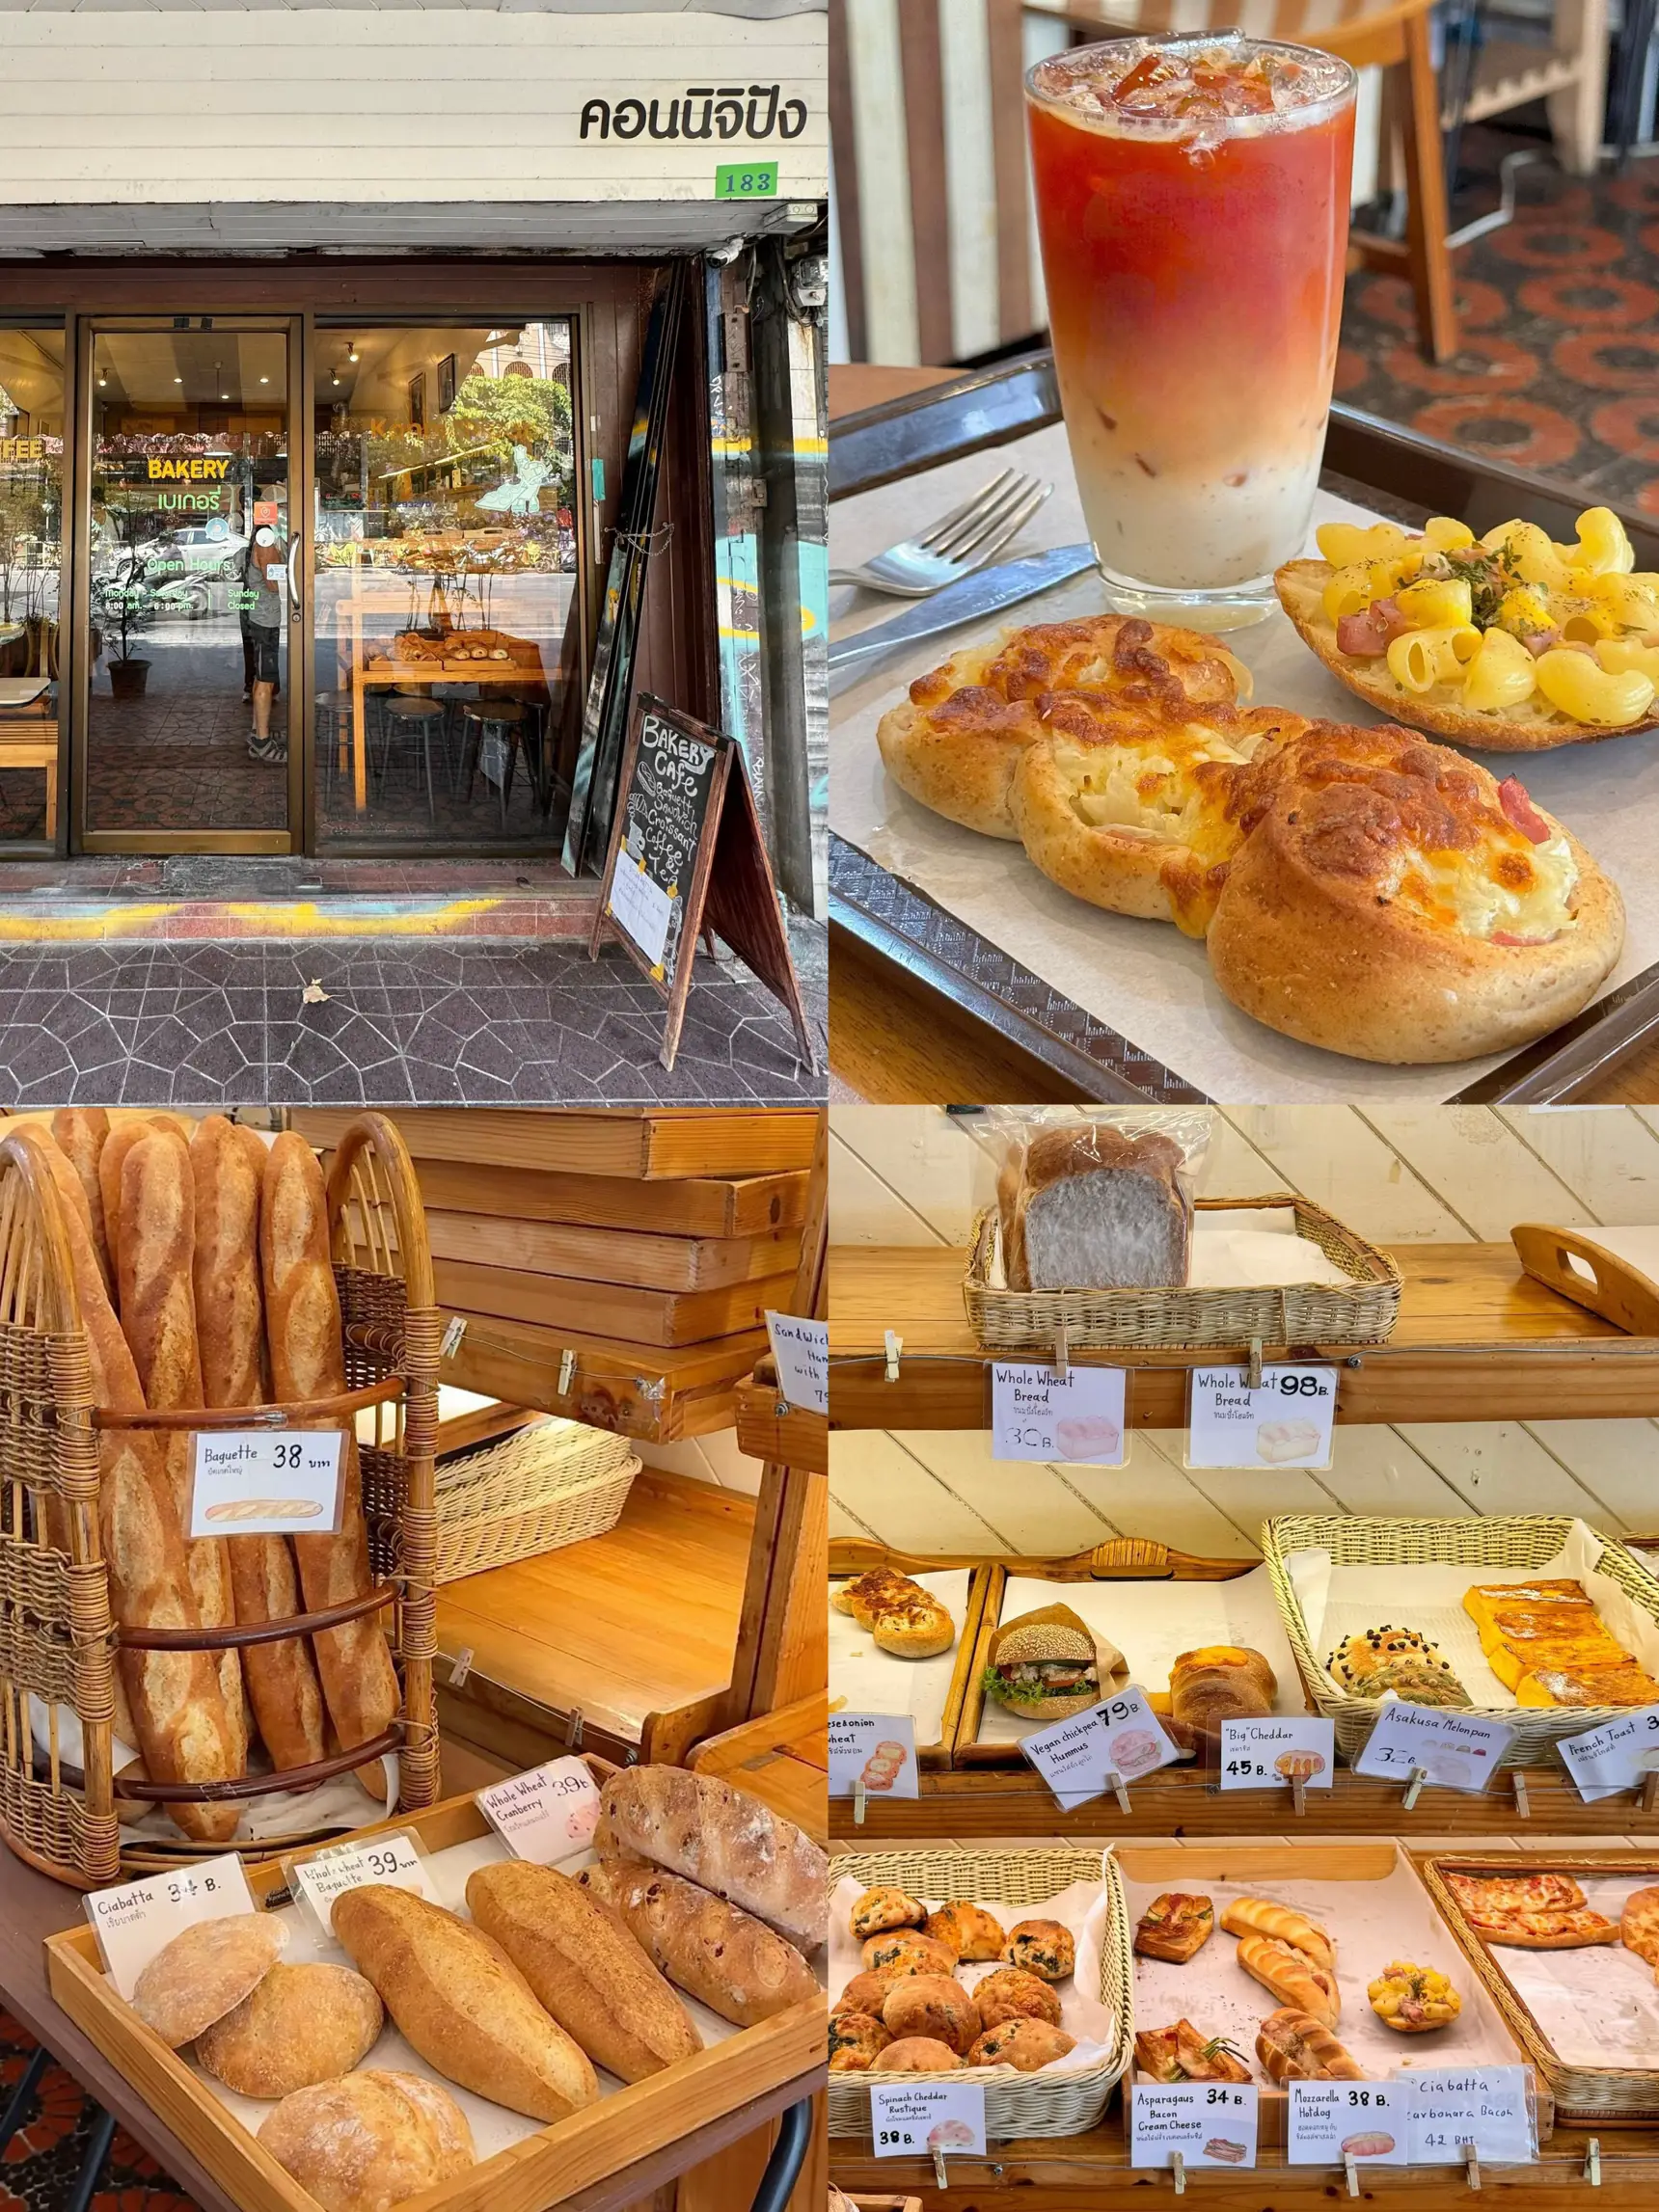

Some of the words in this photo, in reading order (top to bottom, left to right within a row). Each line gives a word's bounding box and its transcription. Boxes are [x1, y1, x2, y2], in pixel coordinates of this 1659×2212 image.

[580, 84, 807, 139] คอนนิจิปัง
[724, 173, 771, 193] 183
[0, 439, 42, 458] FEE
[148, 459, 229, 479] BAKERY
[147, 558, 184, 573] Open
[191, 556, 231, 571] Hours
[228, 588, 259, 601] Sunday
[228, 601, 256, 610] Closed
[642, 715, 715, 775] BAKERY
[645, 826, 684, 867] Coffee
[795, 1365, 820, 1380] with
[996, 1369, 1033, 1385] Whole
[1037, 1370, 1074, 1388] Wheat
[1198, 1373, 1235, 1389] Whole
[1239, 1372, 1278, 1389] Wat
[1014, 1389, 1049, 1403] Bread
[1215, 1392, 1251, 1407] Bread
[204, 1443, 258, 1465] Baguette
[272, 1443, 303, 1469] 38
[309, 1459, 331, 1469] บาท
[1384, 1707, 1439, 1729] Asakusa
[1442, 1719, 1491, 1740] Melonpan
[1030, 1740, 1061, 1756] Vegan
[1062, 1720, 1099, 1742] chickpea
[1250, 1728, 1293, 1740] Cheddar
[1568, 1736, 1604, 1756] French
[1605, 1721, 1636, 1741] Toast
[1049, 1742, 1089, 1764] Hummus
[1226, 1761, 1252, 1775] 45
[486, 1789, 517, 1809] Whole
[514, 1772, 547, 1796] Wheat
[496, 1799, 544, 1821] Cranberry
[367, 1851, 398, 1876] 39
[97, 1890, 154, 1915] Ciabatta
[204, 1877, 222, 1892] B.
[1420, 2078, 1489, 2092] Ciabatta
[879, 2092, 912, 2106] Spinach
[913, 2091, 948, 2101] Cheddar
[1206, 2089, 1229, 2104] 34
[1294, 2088, 1340, 2103] Mozzarella
[1348, 2091, 1370, 2106] 38
[1375, 2094, 1390, 2107] B.
[889, 2104, 928, 2115] Rustique
[1150, 2110, 1177, 2118] Bacon
[1299, 2106, 1331, 2119] Hotdog
[1481, 2105, 1513, 2117] Bacon
[1138, 2120, 1168, 2131] Cream
[1169, 2120, 1202, 2129] Cheese
[880, 2130, 900, 2145] 38
[1425, 2134, 1447, 2146] 42
